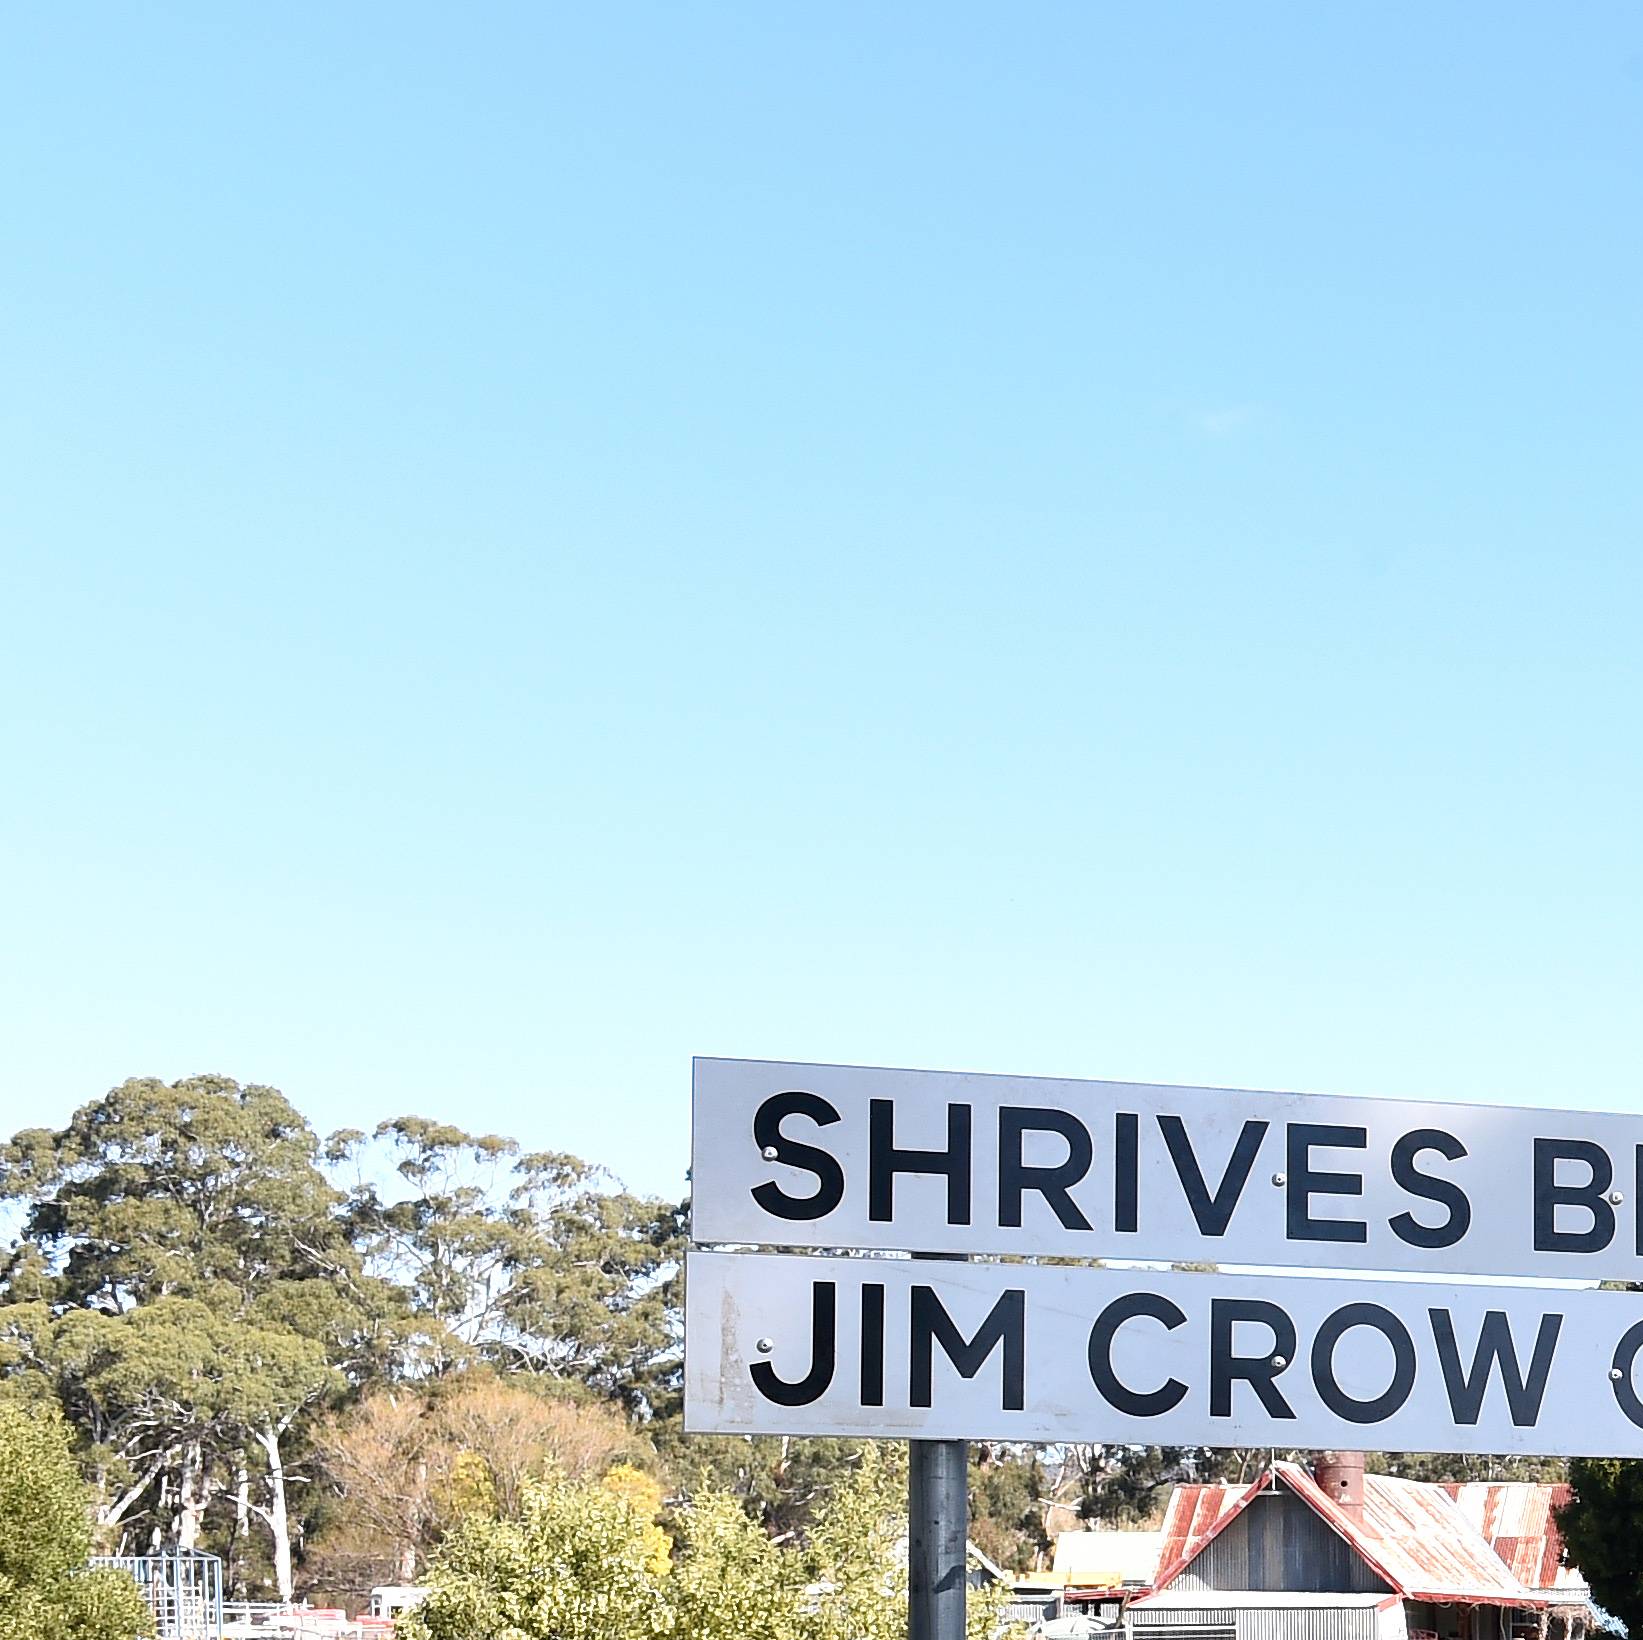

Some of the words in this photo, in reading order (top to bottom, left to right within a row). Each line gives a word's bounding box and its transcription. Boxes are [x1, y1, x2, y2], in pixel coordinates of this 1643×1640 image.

[750, 1090, 1471, 1249] SHRIVES
[749, 1280, 1026, 1411] JIM
[1087, 1291, 1564, 1427] CROW
